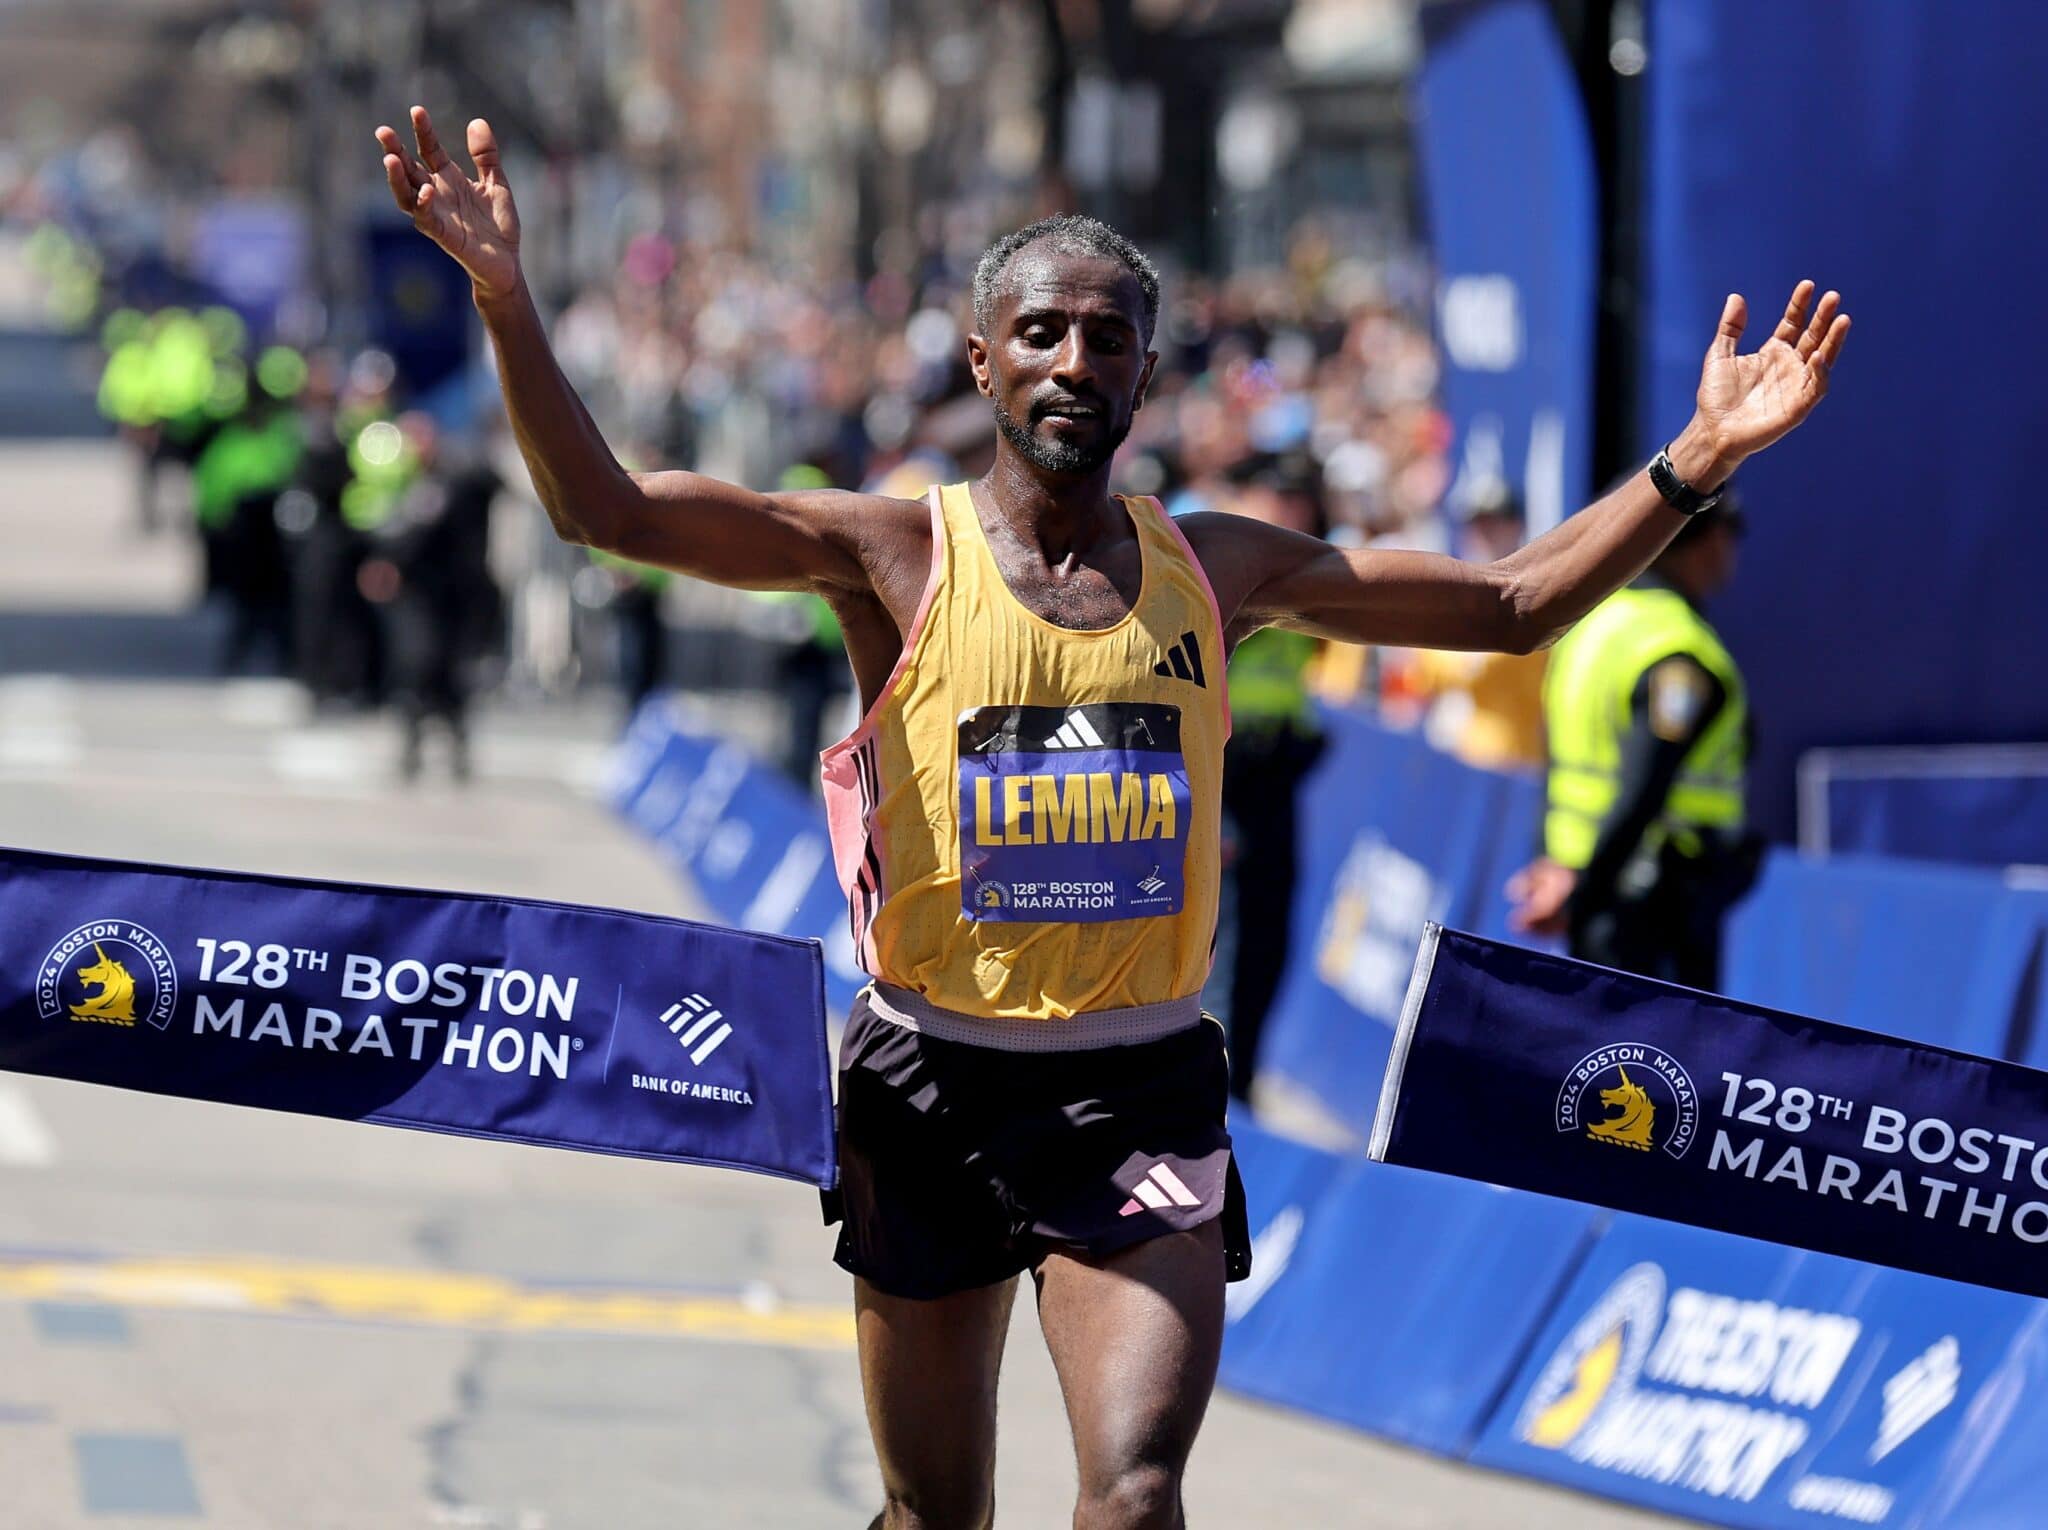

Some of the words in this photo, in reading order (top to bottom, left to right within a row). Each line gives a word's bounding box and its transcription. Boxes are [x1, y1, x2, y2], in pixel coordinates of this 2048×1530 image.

[975, 772, 1176, 846] LEMMA
[1012, 882, 1046, 895] 128TH
[1050, 881, 1114, 894] BOSTON
[1014, 895, 1114, 908] MARATHON
[42, 967, 57, 1010] 2024
[52, 924, 119, 963] BOSTON
[128, 929, 172, 1018] MARATHON
[196, 938, 328, 989] 128TH
[341, 954, 579, 1023] BOSTON
[632, 1074, 669, 1092] BANK
[671, 1080, 690, 1095] OF
[691, 1083, 753, 1105] AMERICA
[1561, 1084, 1579, 1125] 2024
[1576, 1048, 1644, 1081] BOSTON
[1654, 1055, 1693, 1148] MARATHON
[1720, 1072, 1853, 1133] 128TH
